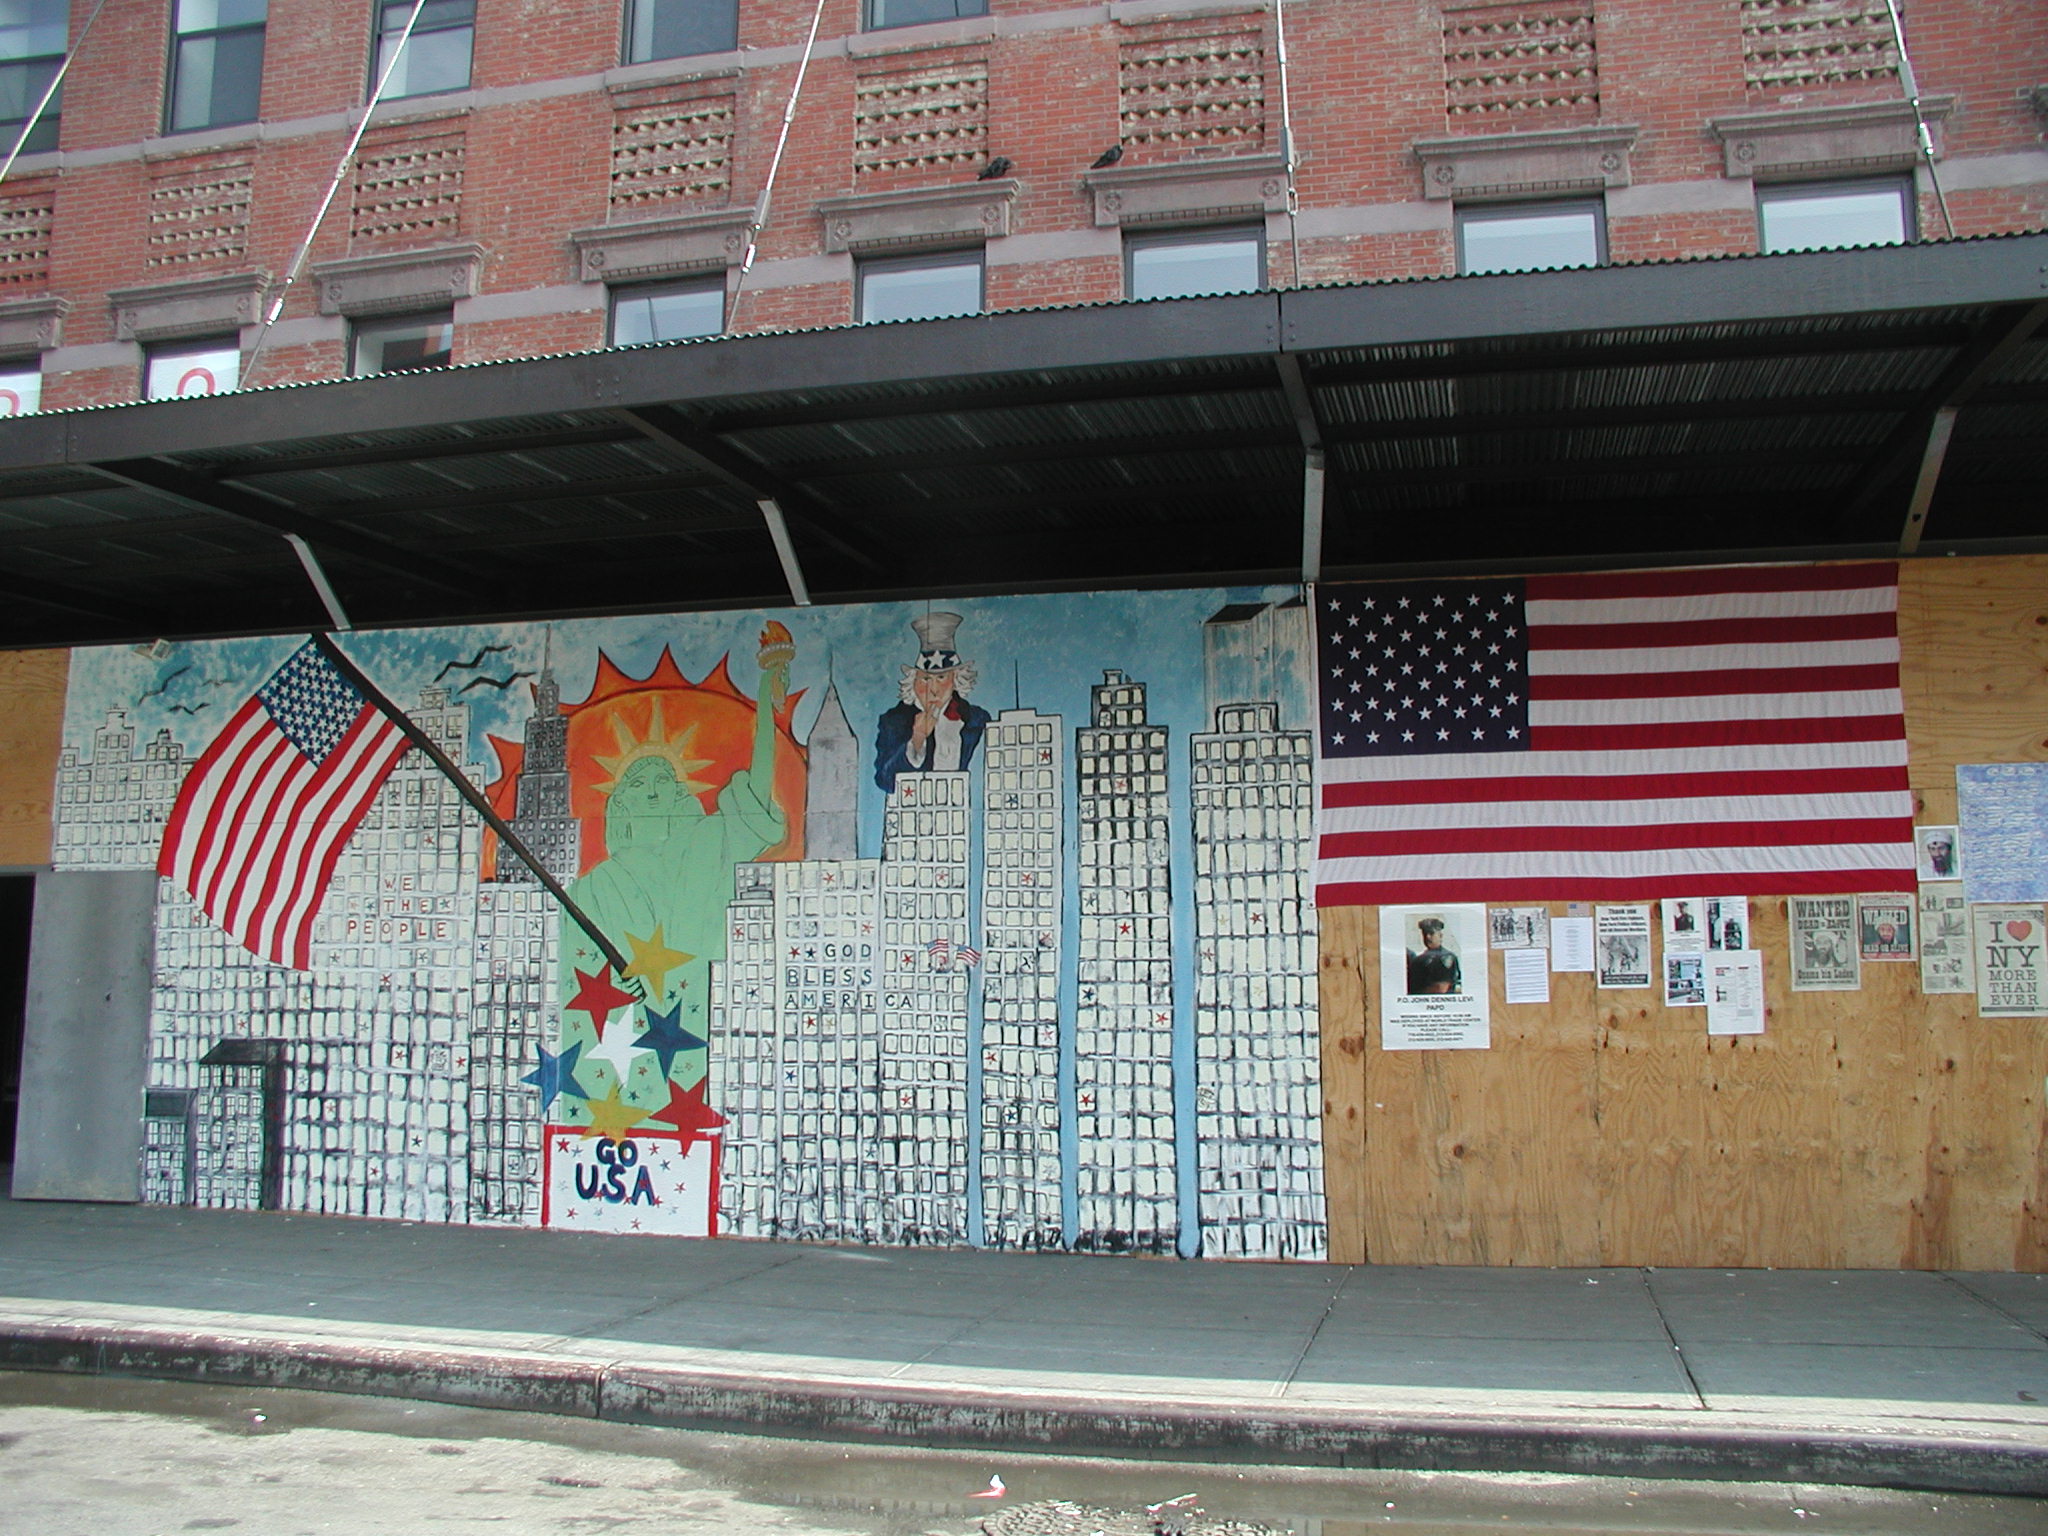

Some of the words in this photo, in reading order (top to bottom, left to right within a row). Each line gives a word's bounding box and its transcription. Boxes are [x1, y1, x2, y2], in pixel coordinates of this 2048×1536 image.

[384, 877, 413, 891] WE
[384, 899, 429, 913] THE
[1796, 900, 1850, 918] WANTED
[347, 920, 447, 938] PEOPLE
[1989, 921, 2003, 943] I
[825, 944, 872, 958] GOD
[1986, 945, 2040, 968] NY
[788, 969, 873, 985] BLESS
[1988, 970, 2037, 981] MORE
[1989, 982, 2037, 993] THAN
[785, 993, 913, 1010] AMERICA
[1990, 994, 2039, 1006] EVER
[596, 1138, 638, 1168] GO
[576, 1162, 657, 1206] USA
